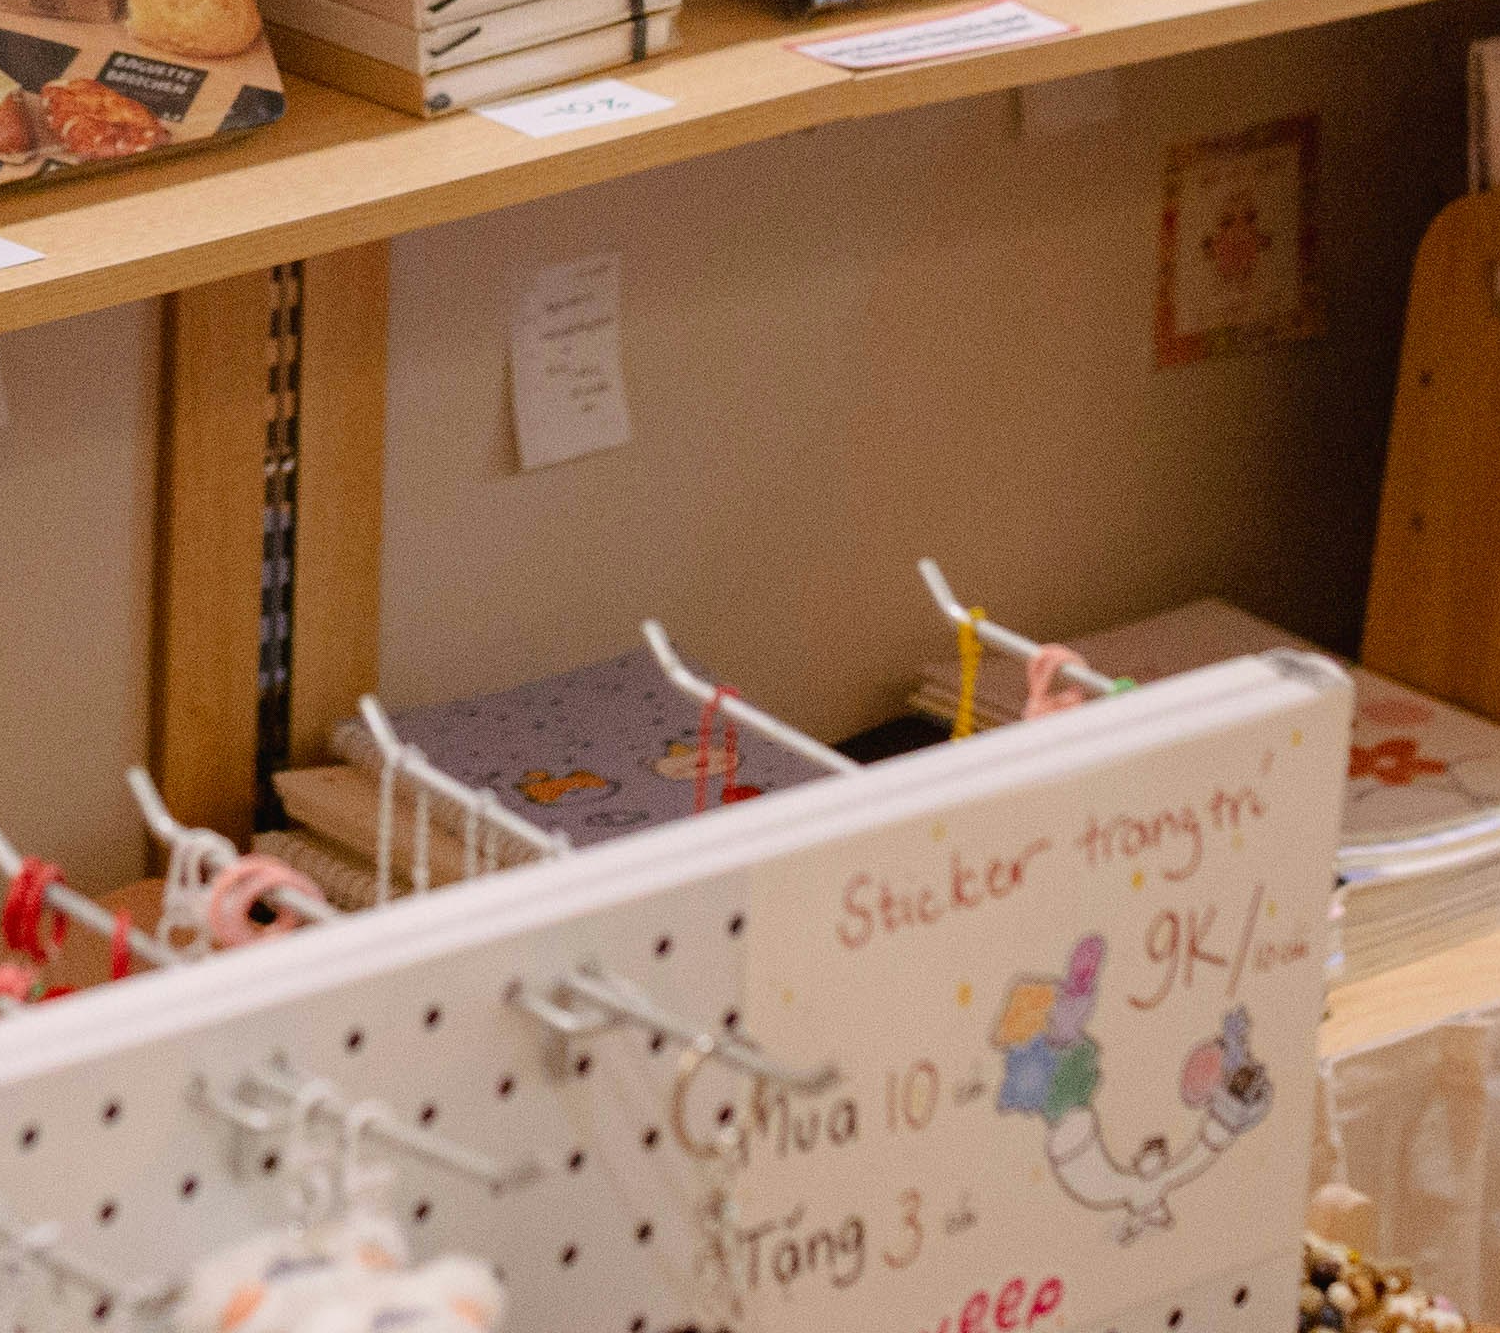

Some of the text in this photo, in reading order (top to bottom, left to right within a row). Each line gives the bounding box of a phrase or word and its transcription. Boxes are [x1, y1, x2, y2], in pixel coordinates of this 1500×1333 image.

[835, 837, 1052, 951] Sticker
[882, 1057, 942, 1133] 10
[882, 1189, 925, 1269] 3
